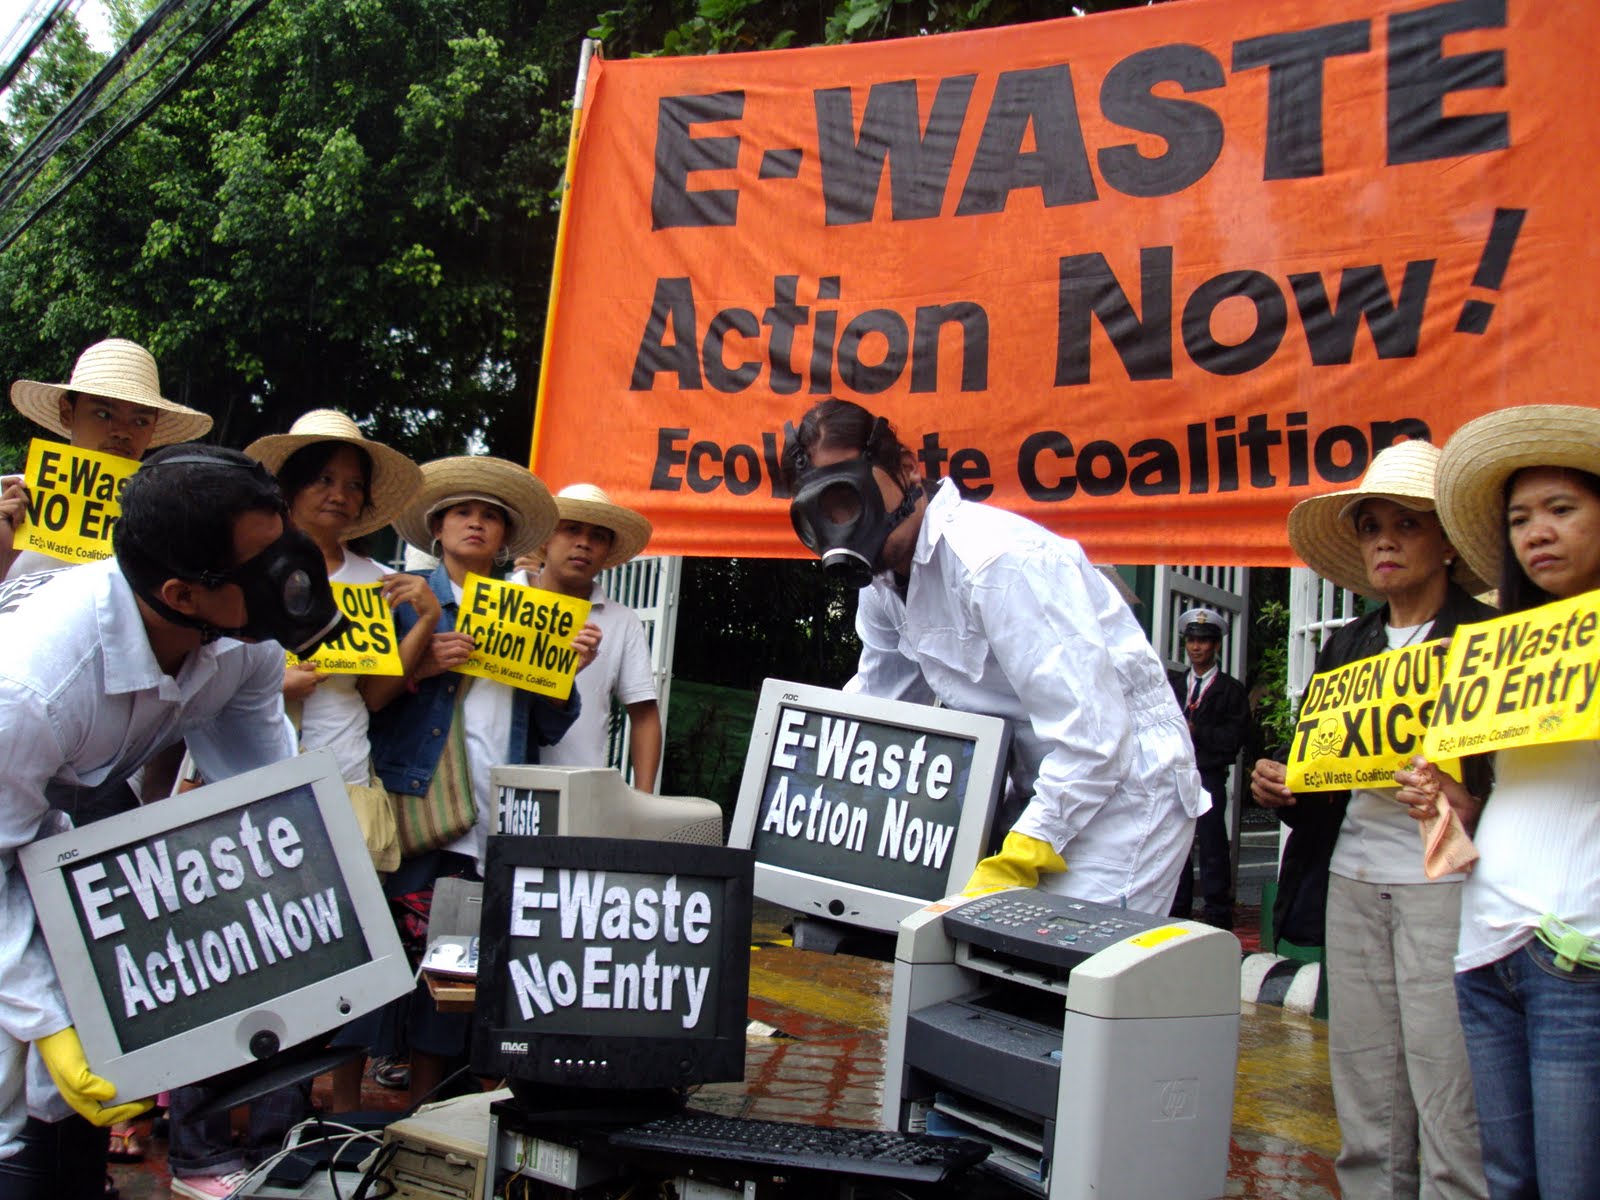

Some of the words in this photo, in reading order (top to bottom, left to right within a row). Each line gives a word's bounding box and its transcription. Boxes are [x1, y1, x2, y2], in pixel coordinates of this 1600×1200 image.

[652, 0, 1510, 231] E-WASTE
[630, 275, 989, 394] Action
[1053, 207, 1528, 388] Now!
[37, 451, 130, 502] E-Was
[650, 427, 994, 501] Ecote
[26, 488, 70, 532] NO
[47, 541, 73, 555] Waste
[460, 614, 525, 662] Action
[529, 632, 578, 675] Now
[473, 582, 574, 638] E-Waste
[1458, 608, 1597, 678] E-Waste
[324, 658, 357, 669] Coalition
[501, 667, 524, 681] Waste
[526, 674, 557, 689] Coalition
[1303, 657, 1390, 716] DESIGN
[1394, 645, 1449, 697] OUT
[1431, 675, 1490, 727] NO
[1495, 658, 1600, 715] Entry
[771, 708, 953, 800] E-Waste
[1488, 725, 1530, 742] Coalition
[1323, 770, 1352, 785] Waste
[762, 776, 869, 852] Action
[877, 797, 955, 869] Now
[72, 811, 304, 940] E-Waste
[510, 866, 712, 944] E-Waste
[114, 928, 259, 1018] Action
[245, 887, 344, 965] Now
[508, 952, 578, 1021] No
[581, 947, 710, 1029] Entry
